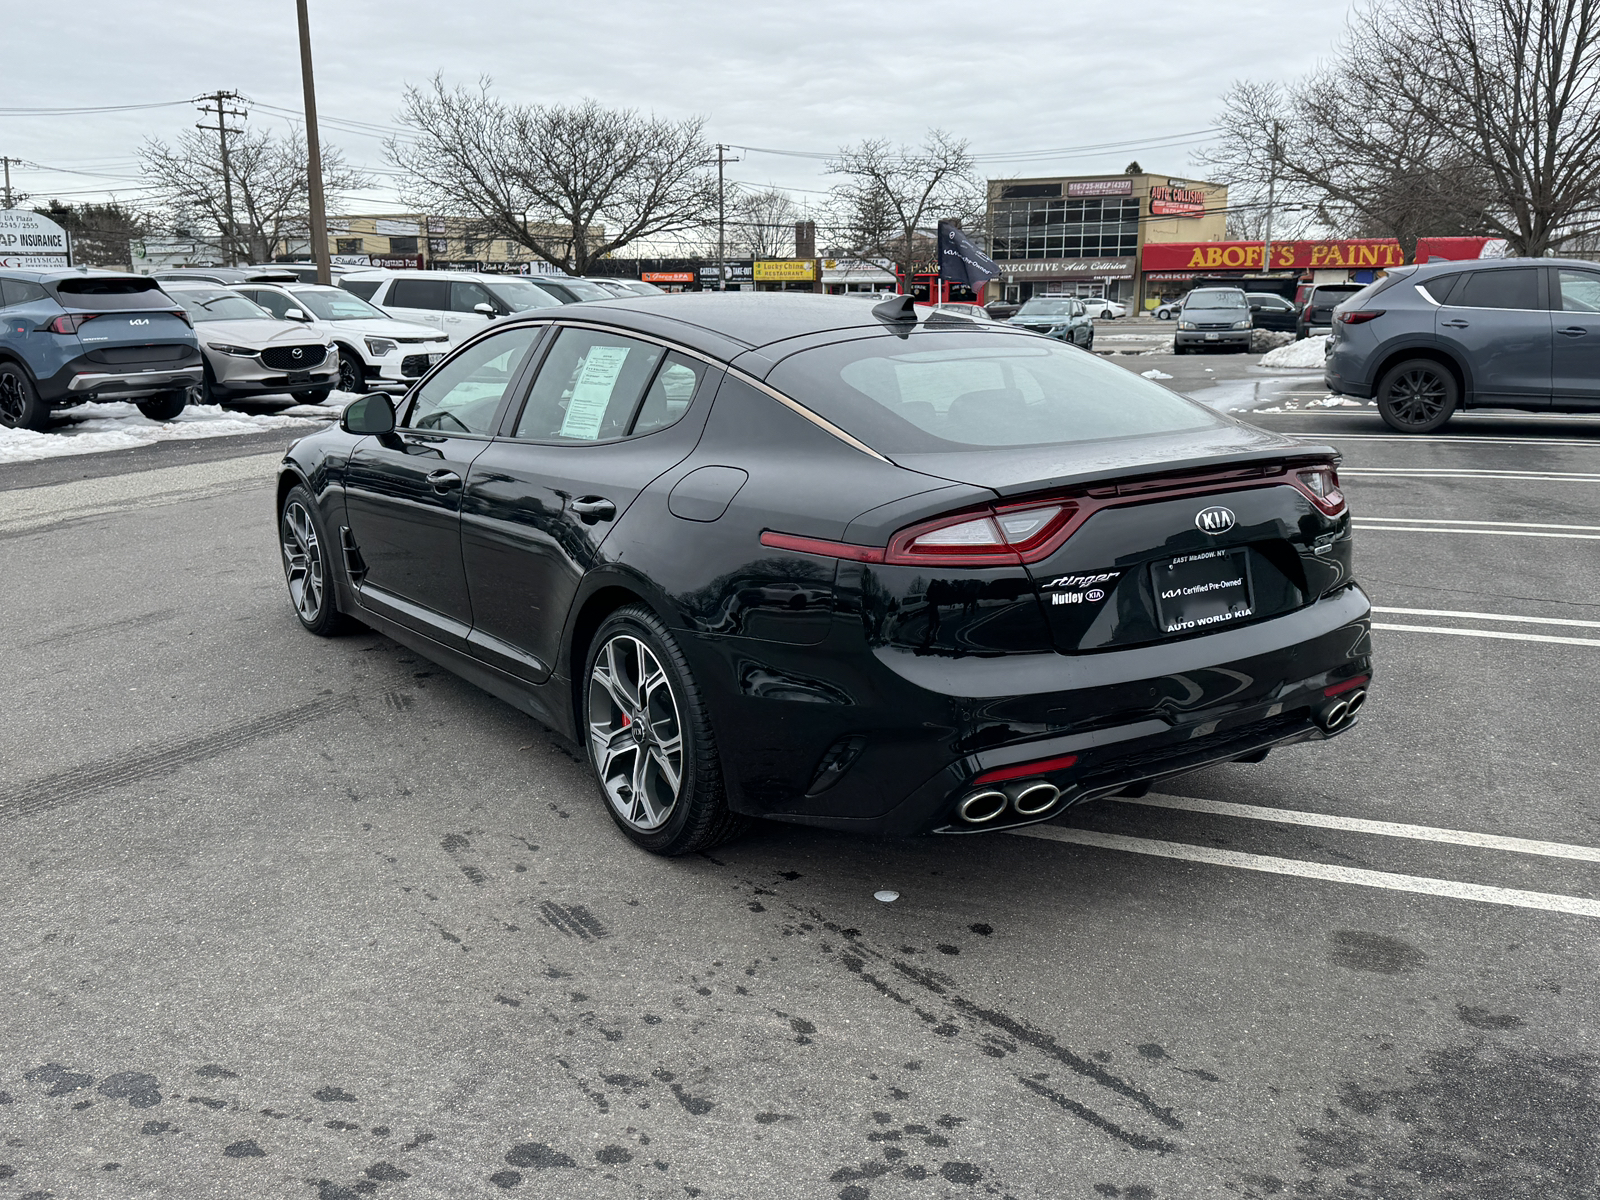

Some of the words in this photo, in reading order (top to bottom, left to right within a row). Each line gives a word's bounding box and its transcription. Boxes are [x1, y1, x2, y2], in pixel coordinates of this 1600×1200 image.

[1173, 188, 1205, 205] COLLISION
[20, 234, 62, 247] INSURANCE
[1187, 246, 1295, 268] ABOFF'S
[764, 263, 783, 271] Lucky
[999, 264, 1059, 273] EXECUTIVE
[1062, 262, 1088, 271] Auto
[1091, 261, 1127, 271] Collision
[1201, 510, 1232, 530] KIA
[1173, 556, 1189, 564] EAST
[1052, 592, 1083, 605] Nutley
[1161, 588, 1181, 599] KIA
[1183, 584, 1209, 595] Certified
[1167, 621, 1195, 632] AUTO
[1197, 613, 1233, 626] WORLD
[1234, 608, 1252, 618] KIA
